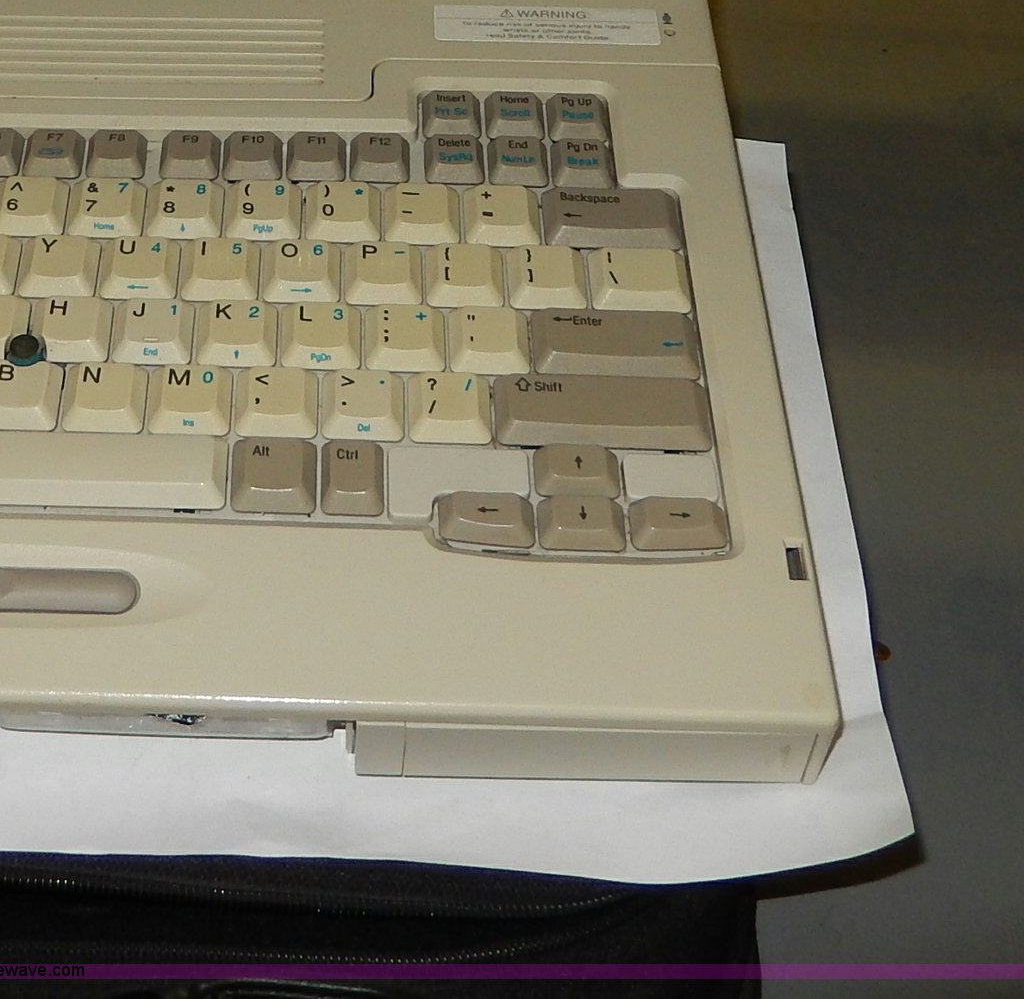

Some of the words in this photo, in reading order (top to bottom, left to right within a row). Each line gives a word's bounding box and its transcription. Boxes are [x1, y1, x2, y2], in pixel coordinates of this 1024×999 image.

[516, 9, 587, 20] WARNING
[436, 93, 466, 103] Insert
[499, 95, 529, 104] Home
[561, 97, 575, 107] Pg
[578, 97, 592, 108] Up
[46, 133, 64, 142] F7
[108, 133, 126, 142] F8
[182, 134, 199, 144] F9
[241, 134, 265, 144] F10
[307, 136, 327, 145] F11
[369, 137, 392, 146] F12
[438, 138, 471, 148] Delete
[508, 139, 529, 149] End
[567, 141, 580, 153] Pg
[584, 142, 599, 152] Dn
[87, 182, 99, 194] &
[118, 183, 129, 194] 7
[196, 184, 207, 195] 8
[275, 185, 286, 196] 9
[559, 191, 621, 204] Backspace
[6, 199, 19, 211] 6
[85, 200, 98, 212] 7
[163, 201, 176, 214] 8
[242, 203, 255, 215] 9
[322, 204, 335, 217] 0
[93, 221, 115, 231] Home
[252, 223, 274, 234] PgUp
[41, 238, 58, 253] Y
[119, 240, 136, 255] U
[151, 242, 161, 253] 4
[232, 243, 243, 255] 5
[281, 243, 298, 258] O
[312, 244, 324, 256] 6
[362, 244, 378, 259] P
[49, 300, 68, 316] H
[133, 303, 146, 317] J
[170, 305, 177, 316] 1
[216, 304, 232, 320] K
[249, 306, 261, 319] 2
[299, 306, 313, 322] L
[333, 308, 345, 321] 3
[572, 315, 603, 328] Enter
[142, 347, 158, 357] End
[310, 353, 332, 363] PgDn
[82, 366, 103, 384] N
[167, 368, 192, 387] M
[202, 371, 214, 385] 0
[427, 378, 438, 392] ?
[533, 380, 563, 394] Shift
[182, 418, 195, 428] Ins
[357, 423, 371, 433] Del
[252, 444, 270, 458] Alt
[336, 448, 359, 461] Ctrl
